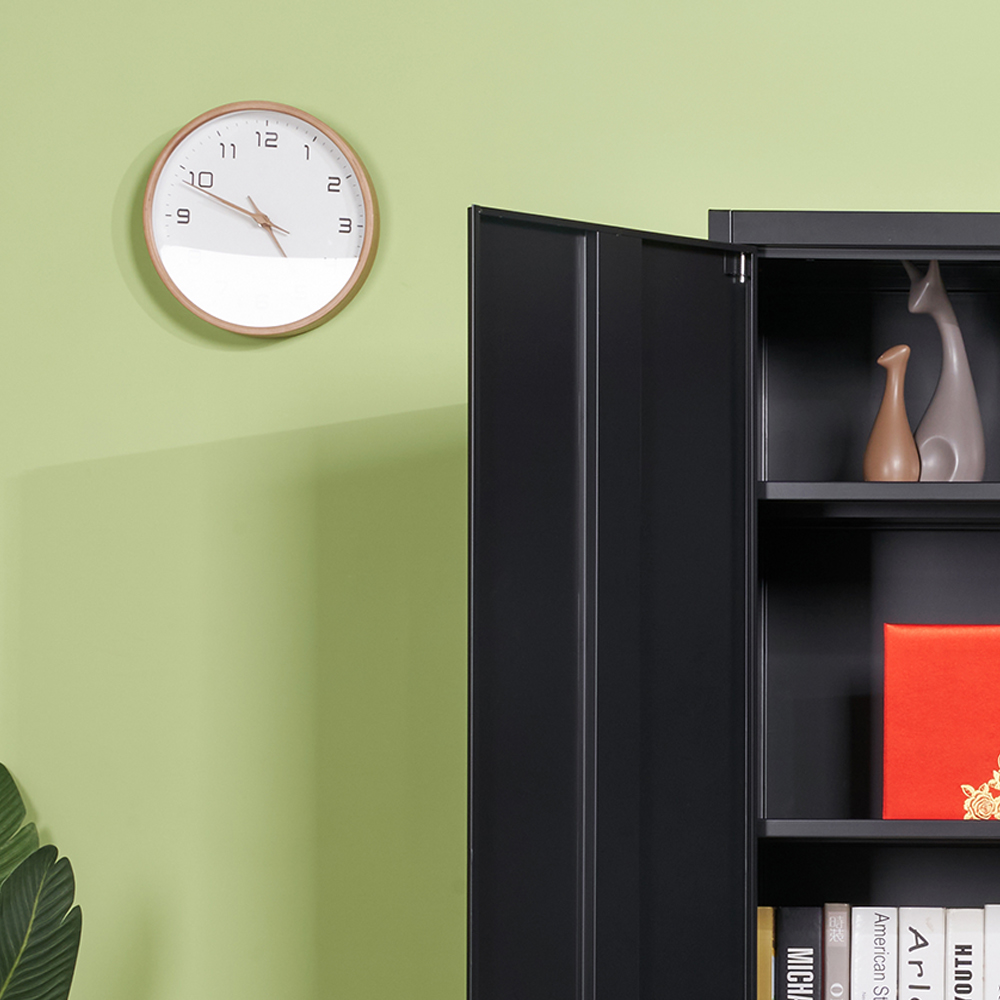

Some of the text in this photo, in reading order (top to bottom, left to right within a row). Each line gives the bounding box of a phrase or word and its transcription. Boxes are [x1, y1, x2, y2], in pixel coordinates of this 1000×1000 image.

[256, 131, 278, 148] 12
[219, 142, 237, 159] 11
[304, 144, 311, 161] 1
[188, 171, 214, 188] 10
[327, 176, 342, 193] 2
[176, 208, 190, 224] 9
[338, 217, 352, 234] 3
[873, 912, 890, 981] American
